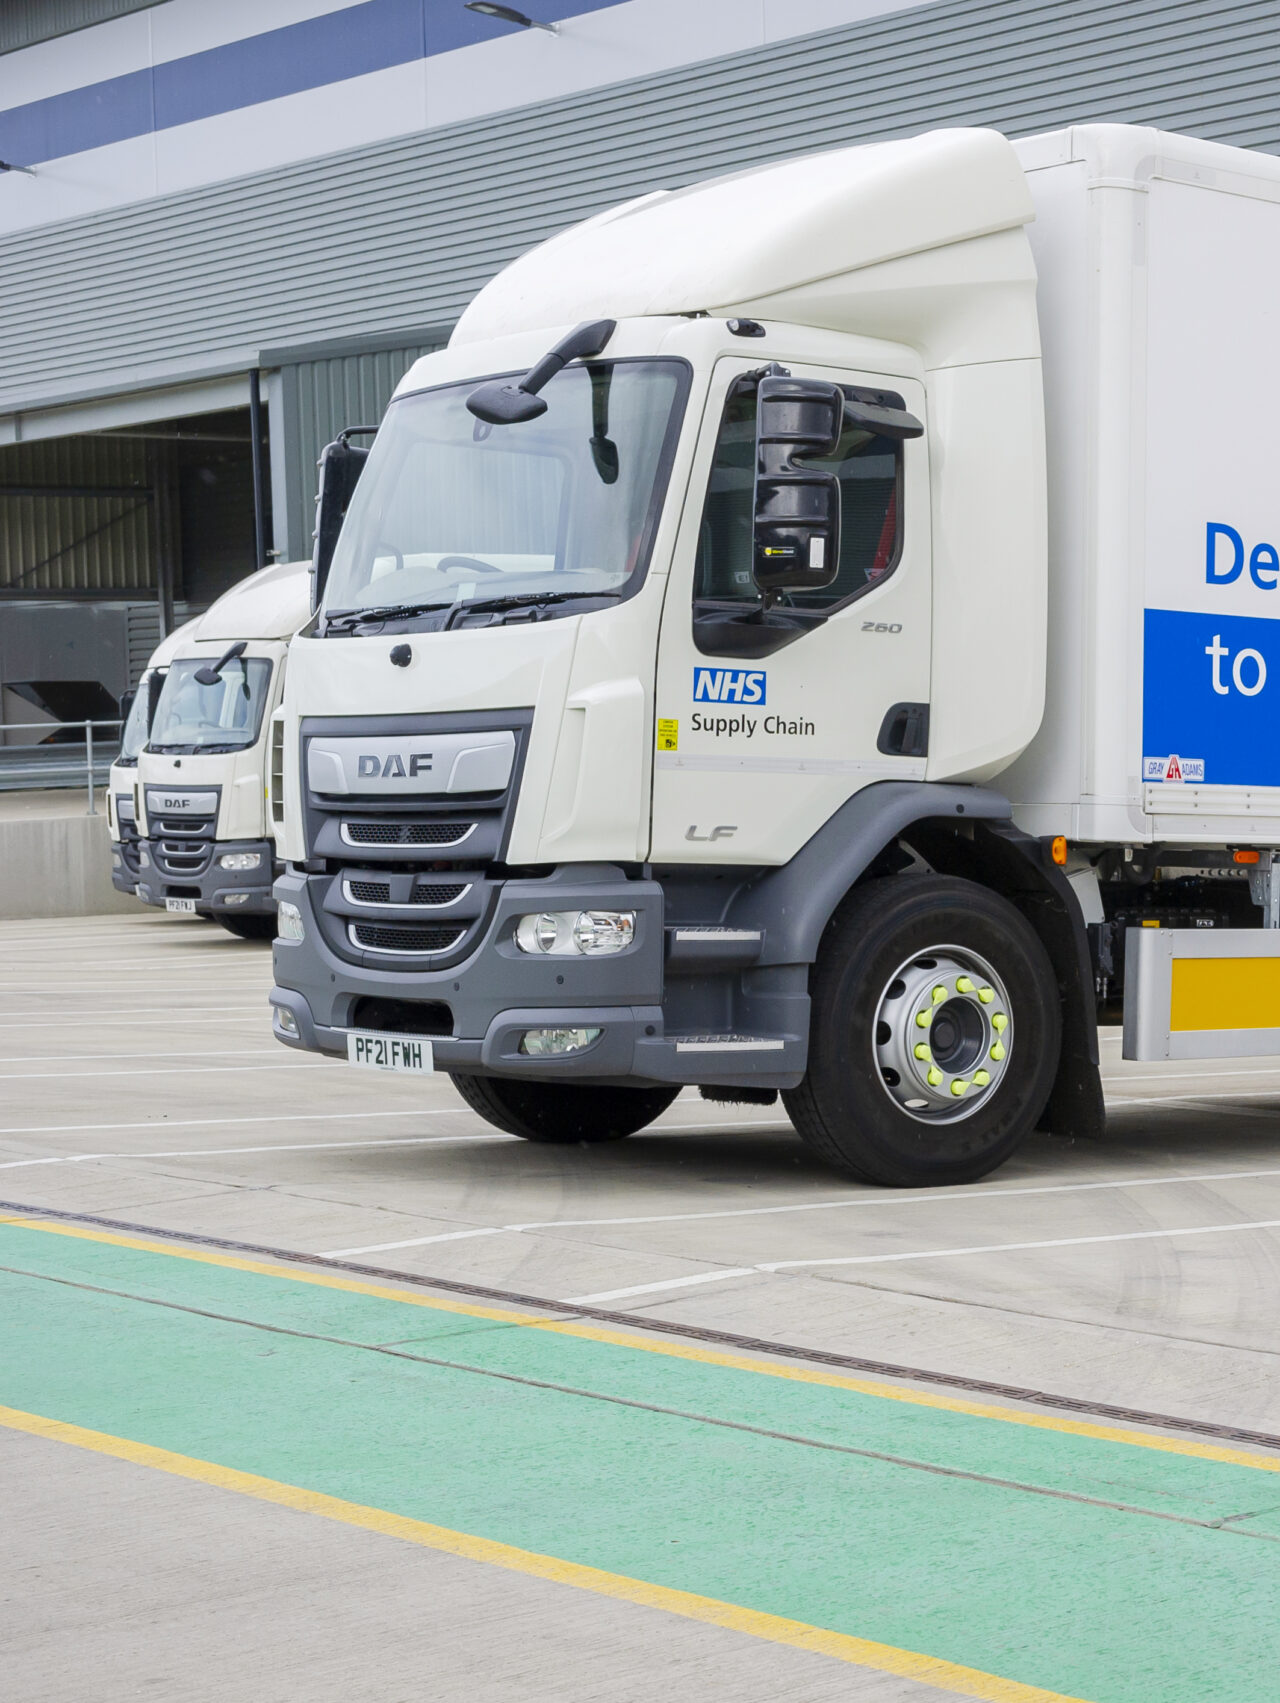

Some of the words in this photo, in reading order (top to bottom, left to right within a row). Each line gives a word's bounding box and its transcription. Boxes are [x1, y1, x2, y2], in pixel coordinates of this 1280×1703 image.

[860, 621, 903, 634] 260
[1204, 634, 1267, 697] to
[694, 669, 765, 703] NHS
[691, 712, 758, 738] Supply
[763, 715, 816, 736] Chain
[358, 753, 433, 778] DAF
[1148, 761, 1165, 775] GRAY
[1181, 763, 1203, 777] ADAMS
[164, 799, 190, 808] DAF
[685, 825, 738, 842] LF
